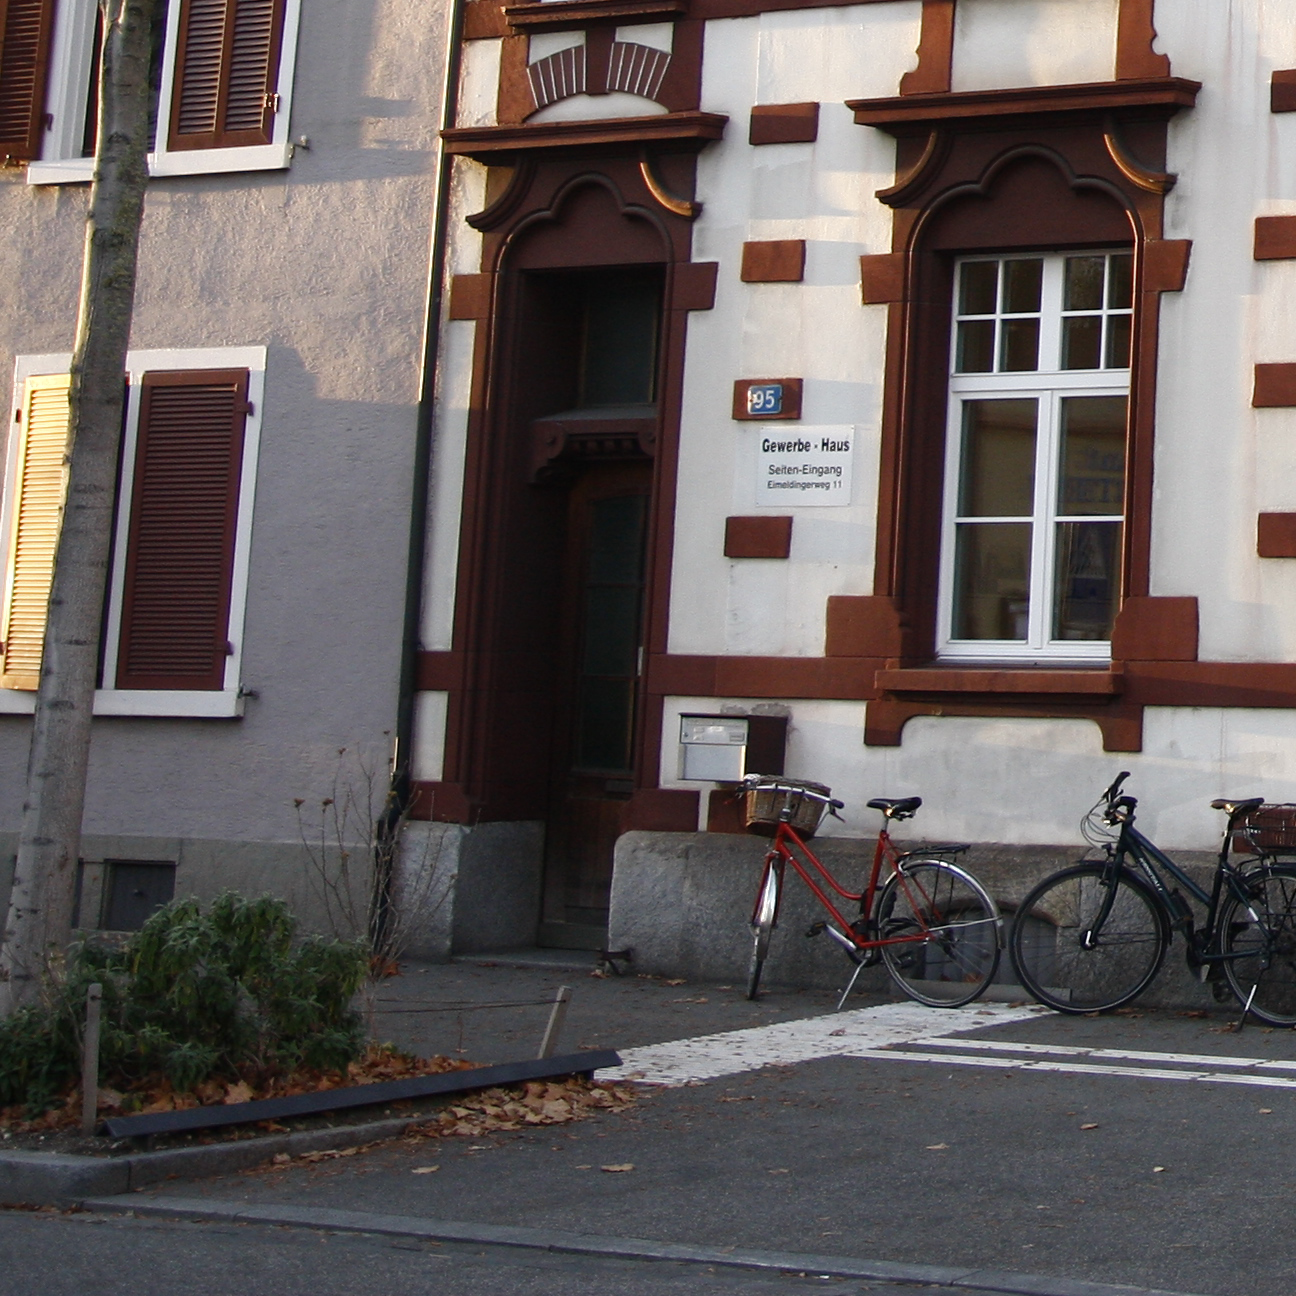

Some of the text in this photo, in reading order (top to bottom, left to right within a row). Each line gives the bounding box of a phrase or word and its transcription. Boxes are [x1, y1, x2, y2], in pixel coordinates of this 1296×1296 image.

[754, 390, 775, 409] 95
[762, 438, 811, 453] Gewerbe
[821, 438, 850, 452] Haus
[768, 464, 842, 477] Seiten-Eingang
[767, 480, 842, 491] Eimeldingerweg 11
